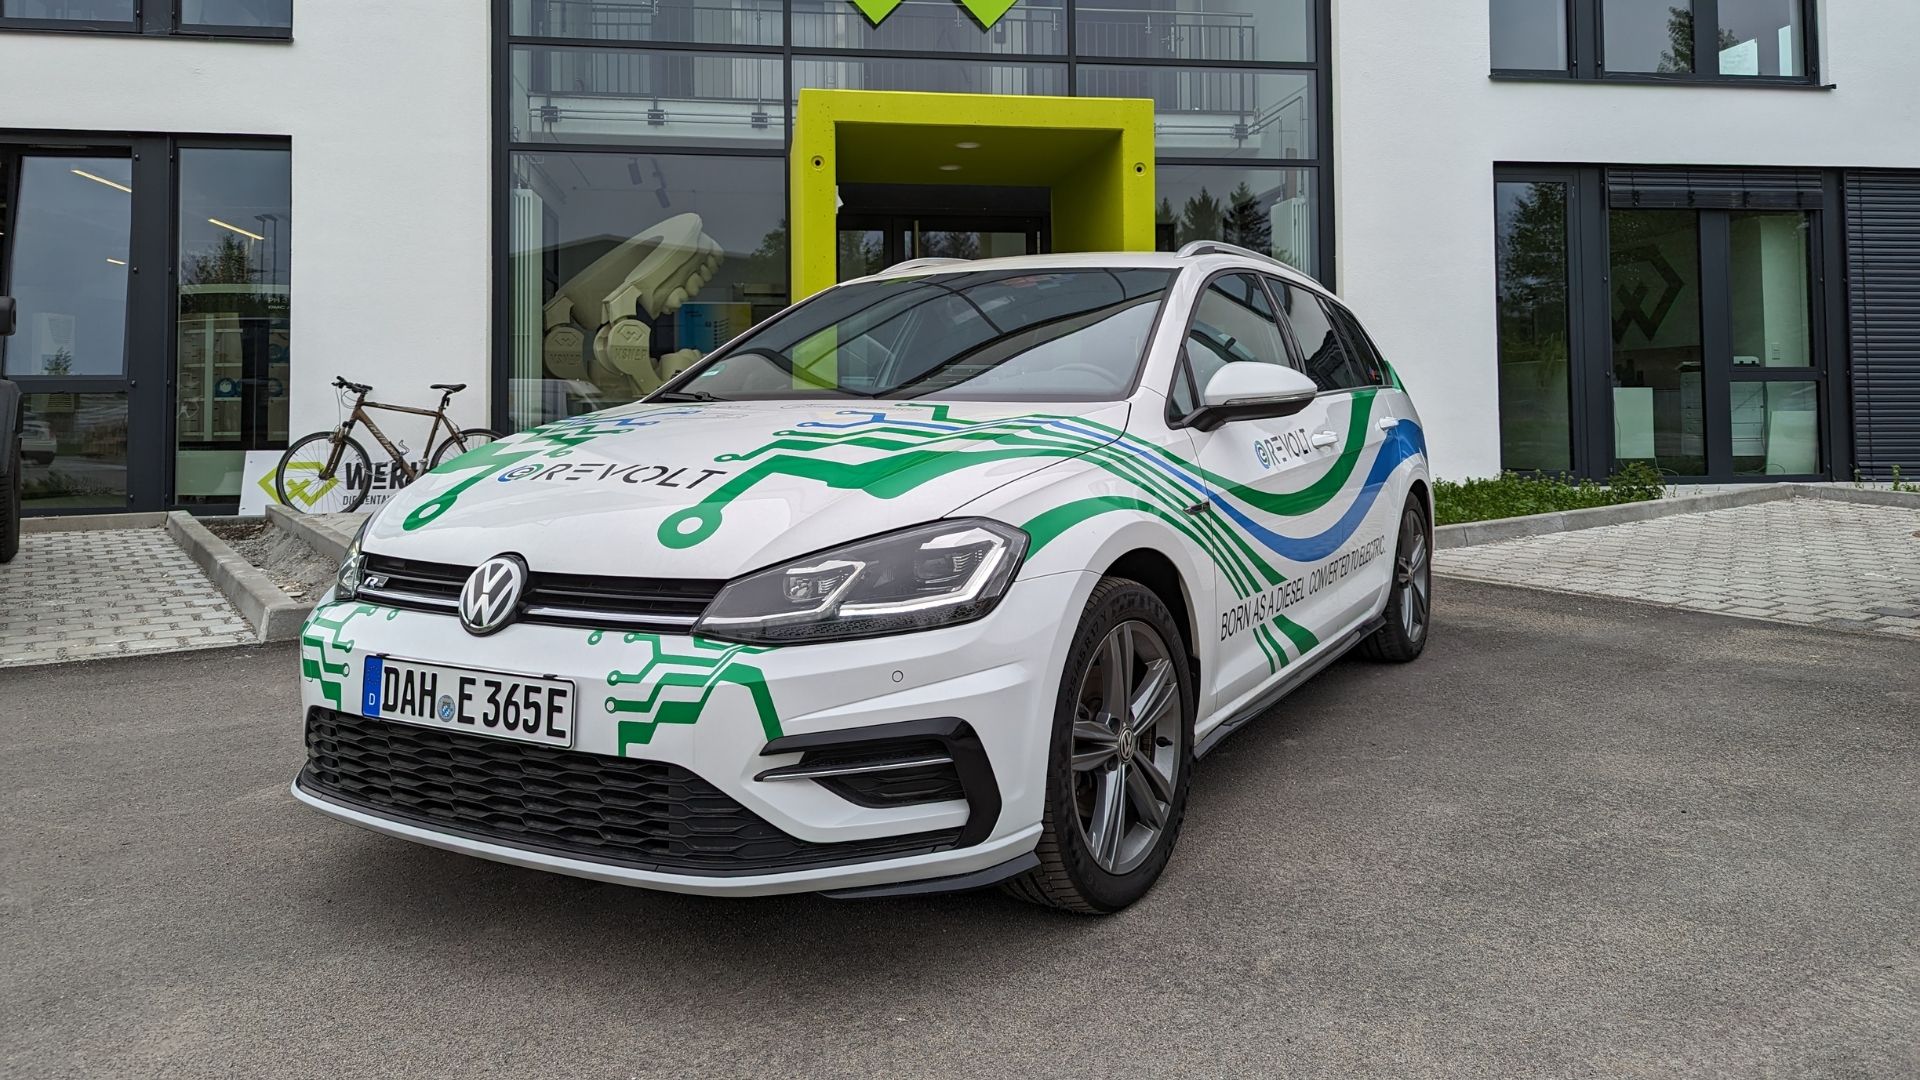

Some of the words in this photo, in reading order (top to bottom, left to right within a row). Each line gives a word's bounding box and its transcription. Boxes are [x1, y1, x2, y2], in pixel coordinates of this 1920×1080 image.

[1220, 601, 1252, 642] BORN
[1252, 594, 1267, 625] AS
[1267, 590, 1274, 618] A
[1276, 577, 1305, 613] DIESEL
[1308, 553, 1351, 595] CONVERTED
[1351, 548, 1360, 572] TO
[368, 692, 376, 706] D
[382, 666, 438, 720] DAH
[457, 676, 477, 725] E
[482, 679, 568, 739] 365E
